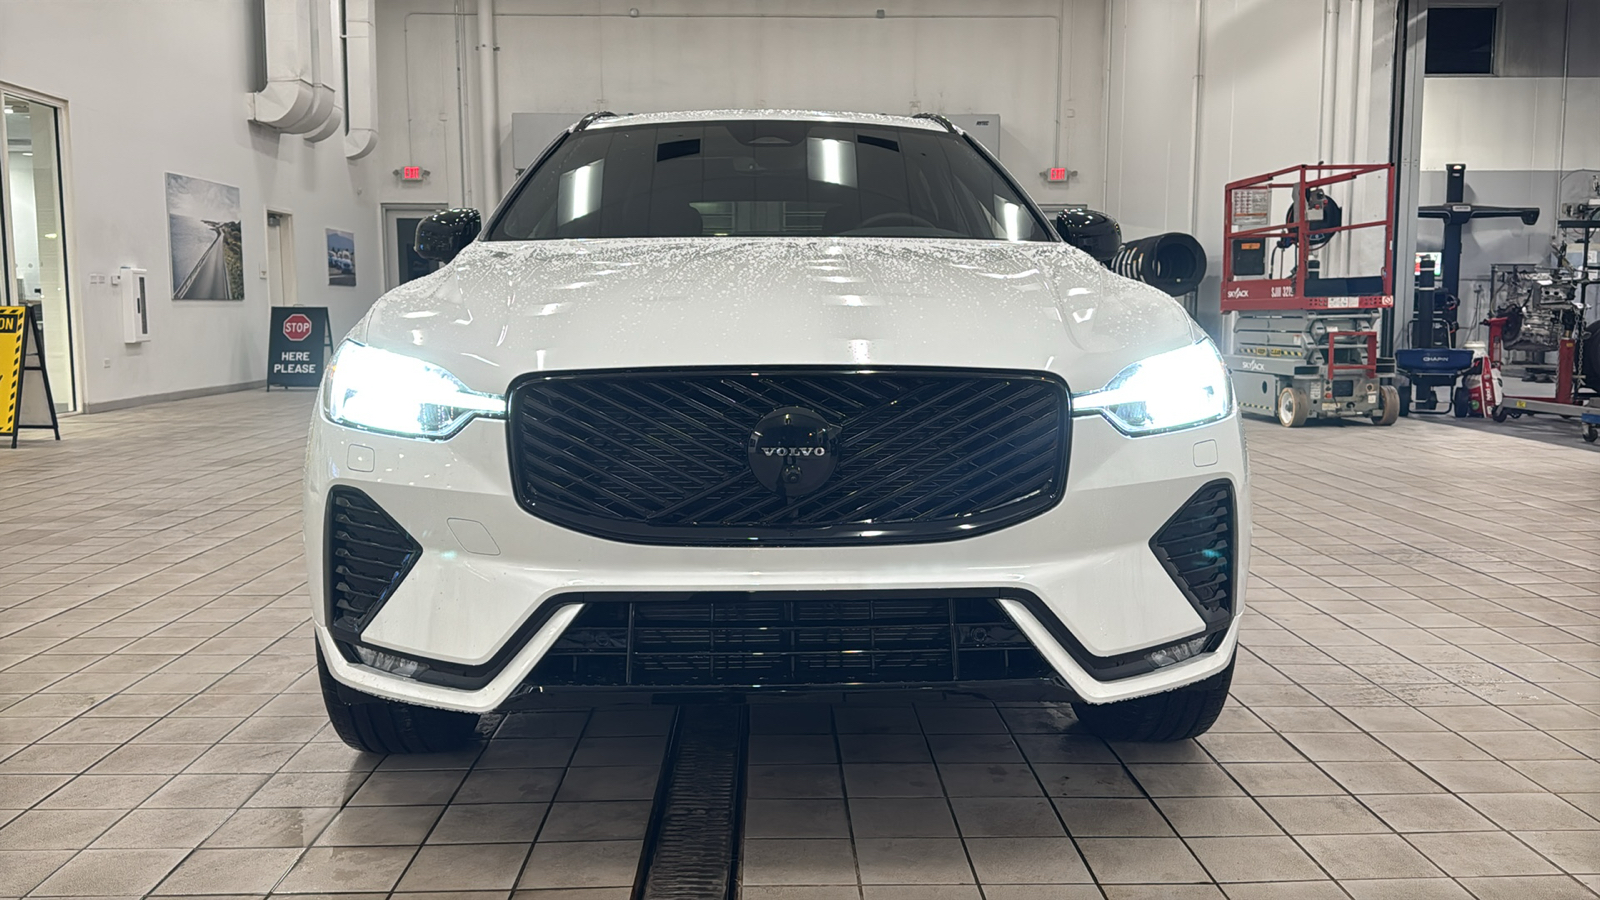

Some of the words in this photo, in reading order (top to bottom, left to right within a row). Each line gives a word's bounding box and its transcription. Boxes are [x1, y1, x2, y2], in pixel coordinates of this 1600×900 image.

[404, 166, 420, 179] EXIT
[1050, 167, 1066, 180] EXIT
[285, 322, 310, 333] STOP
[281, 351, 310, 361] HERE
[273, 364, 316, 374] PLEASE
[761, 447, 826, 457] VOLVO
